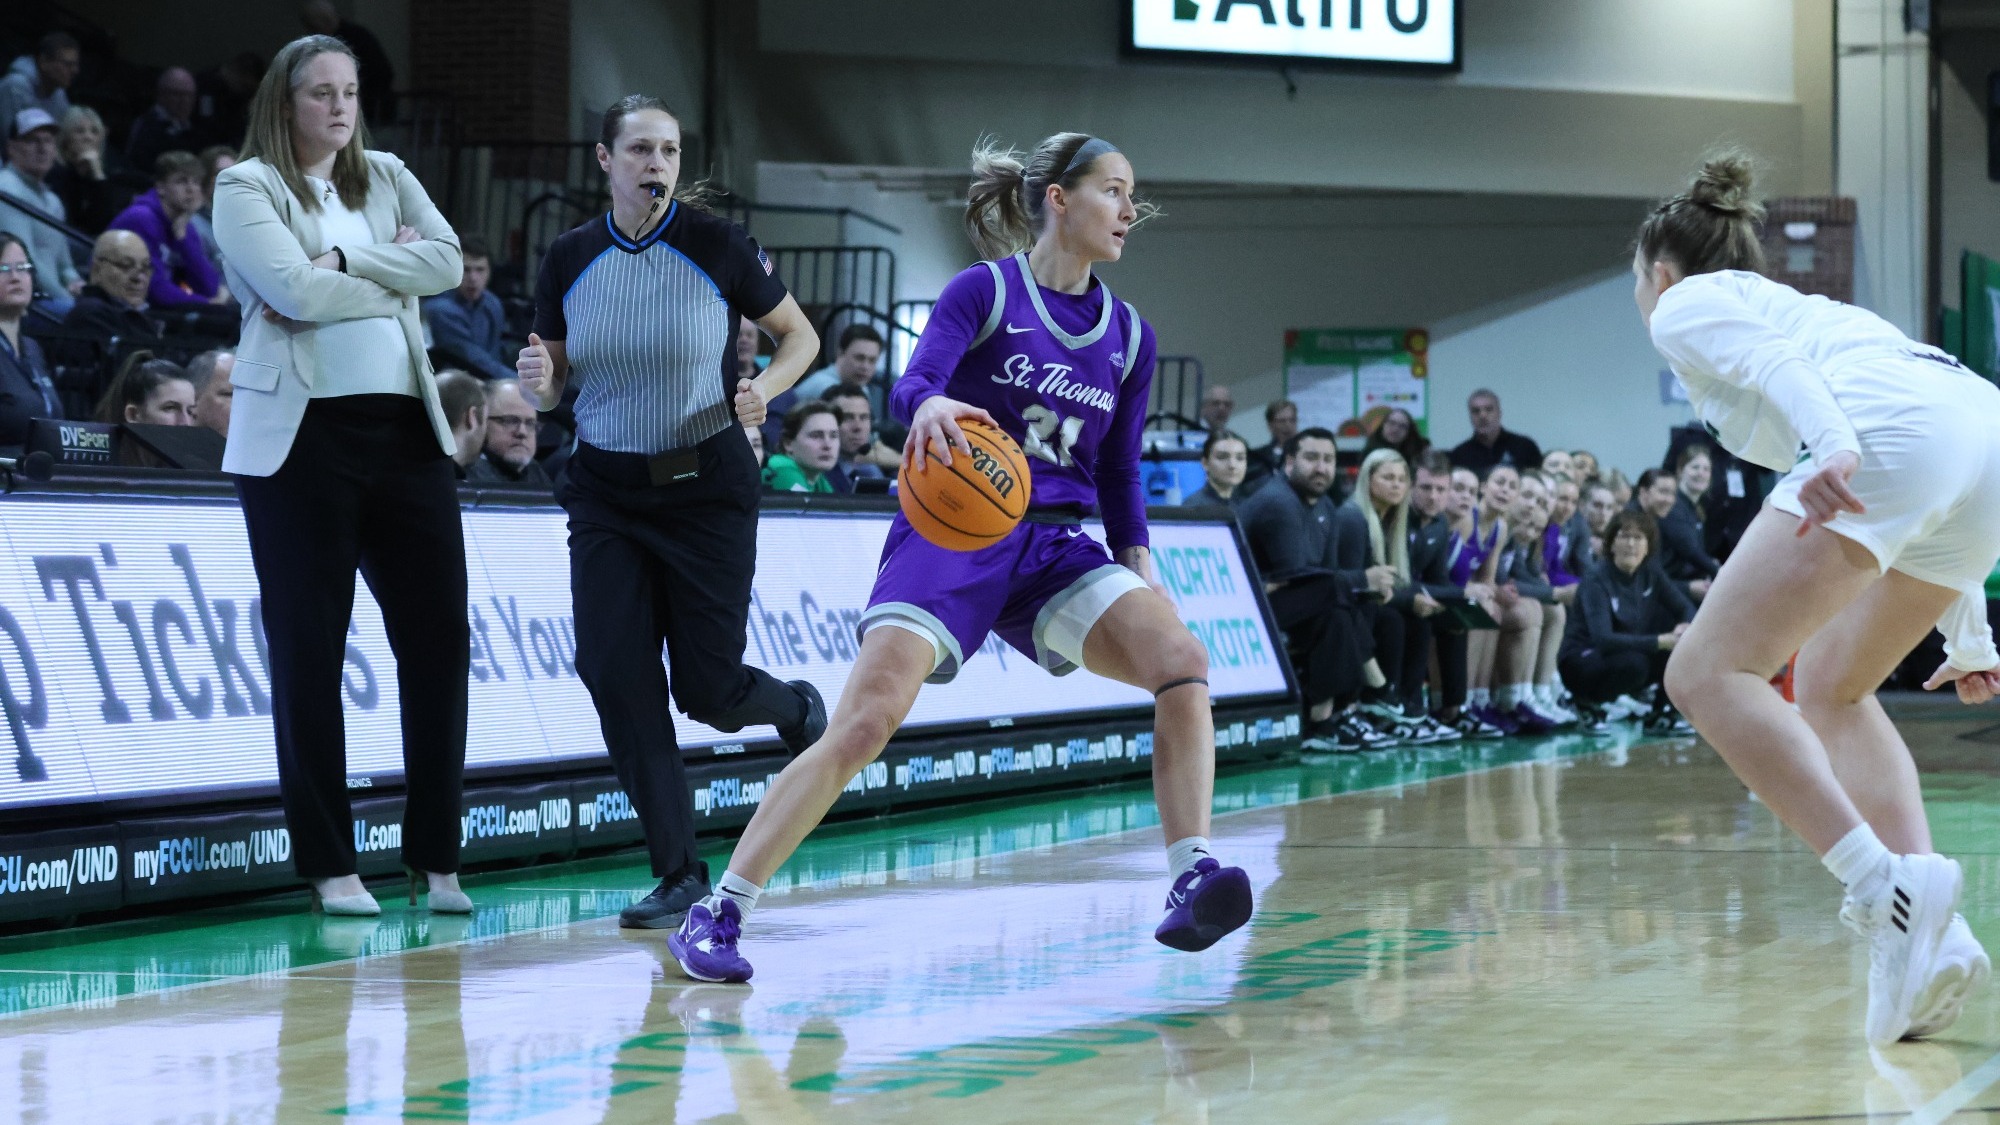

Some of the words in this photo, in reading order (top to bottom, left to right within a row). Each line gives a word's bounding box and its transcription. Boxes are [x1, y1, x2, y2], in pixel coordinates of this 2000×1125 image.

[991, 354, 1035, 389] St.
[1037, 363, 1115, 413] Thomas
[1021, 403, 1085, 467] 21
[1151, 547, 1236, 608] NORTH
[134, 828, 290, 886] myFCCU.com/UND
